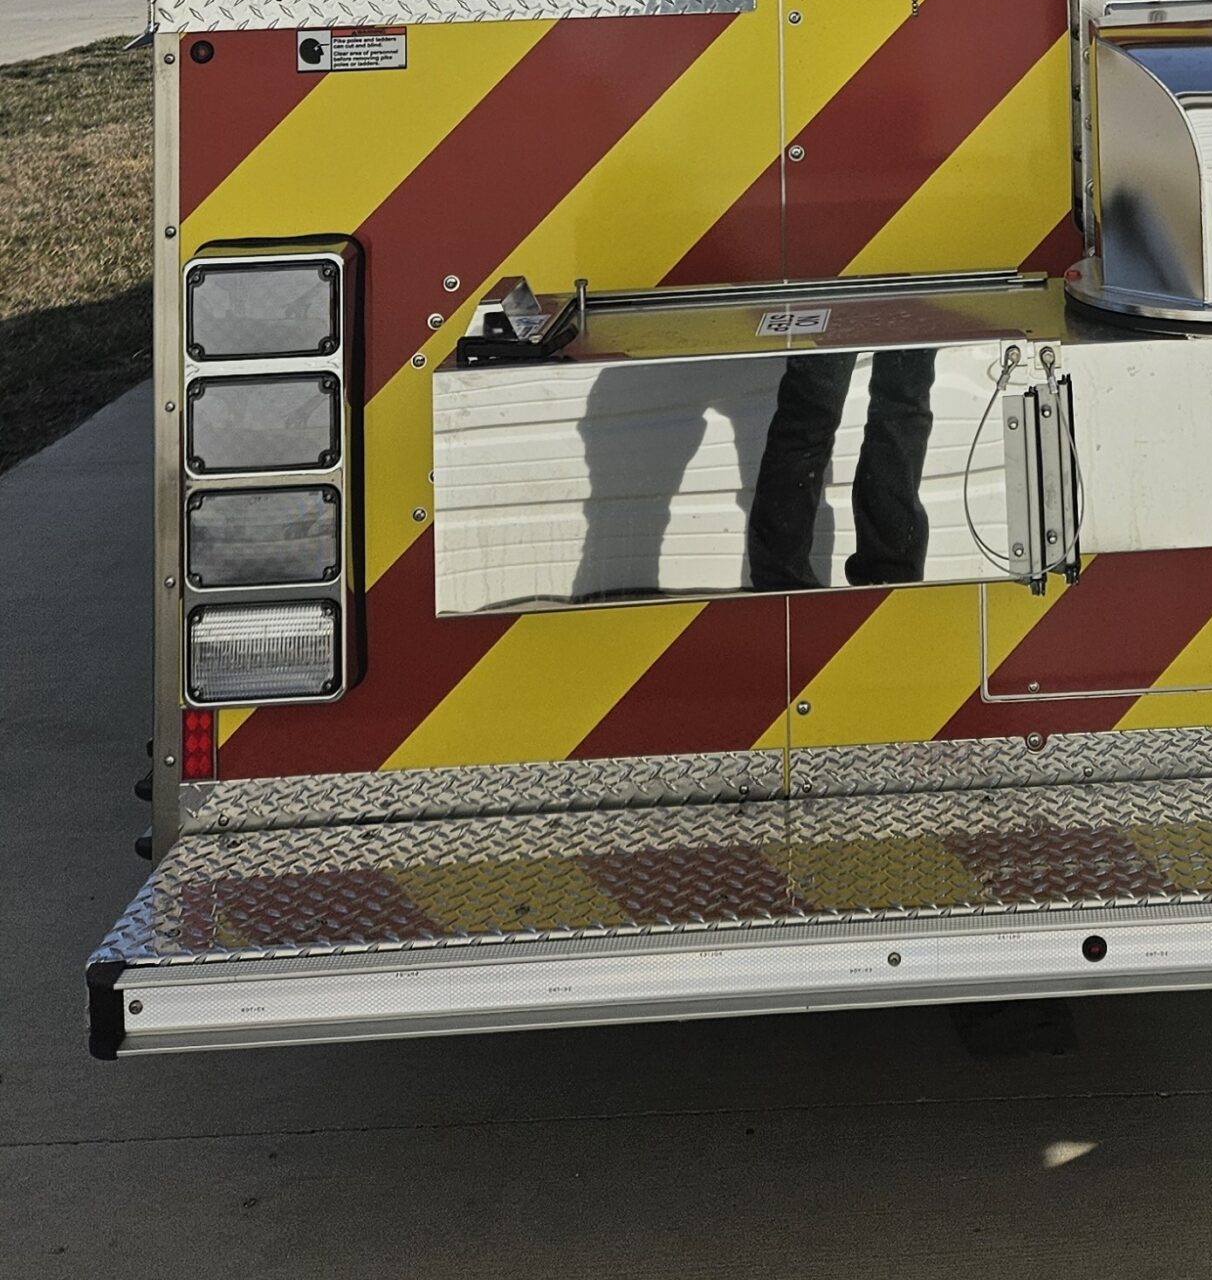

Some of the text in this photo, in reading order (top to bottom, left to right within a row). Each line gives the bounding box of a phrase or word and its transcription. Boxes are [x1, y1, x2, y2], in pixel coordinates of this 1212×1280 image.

[370, 49, 398, 57] personnel
[767, 314, 795, 332] STEP
[795, 315, 820, 327] NO
